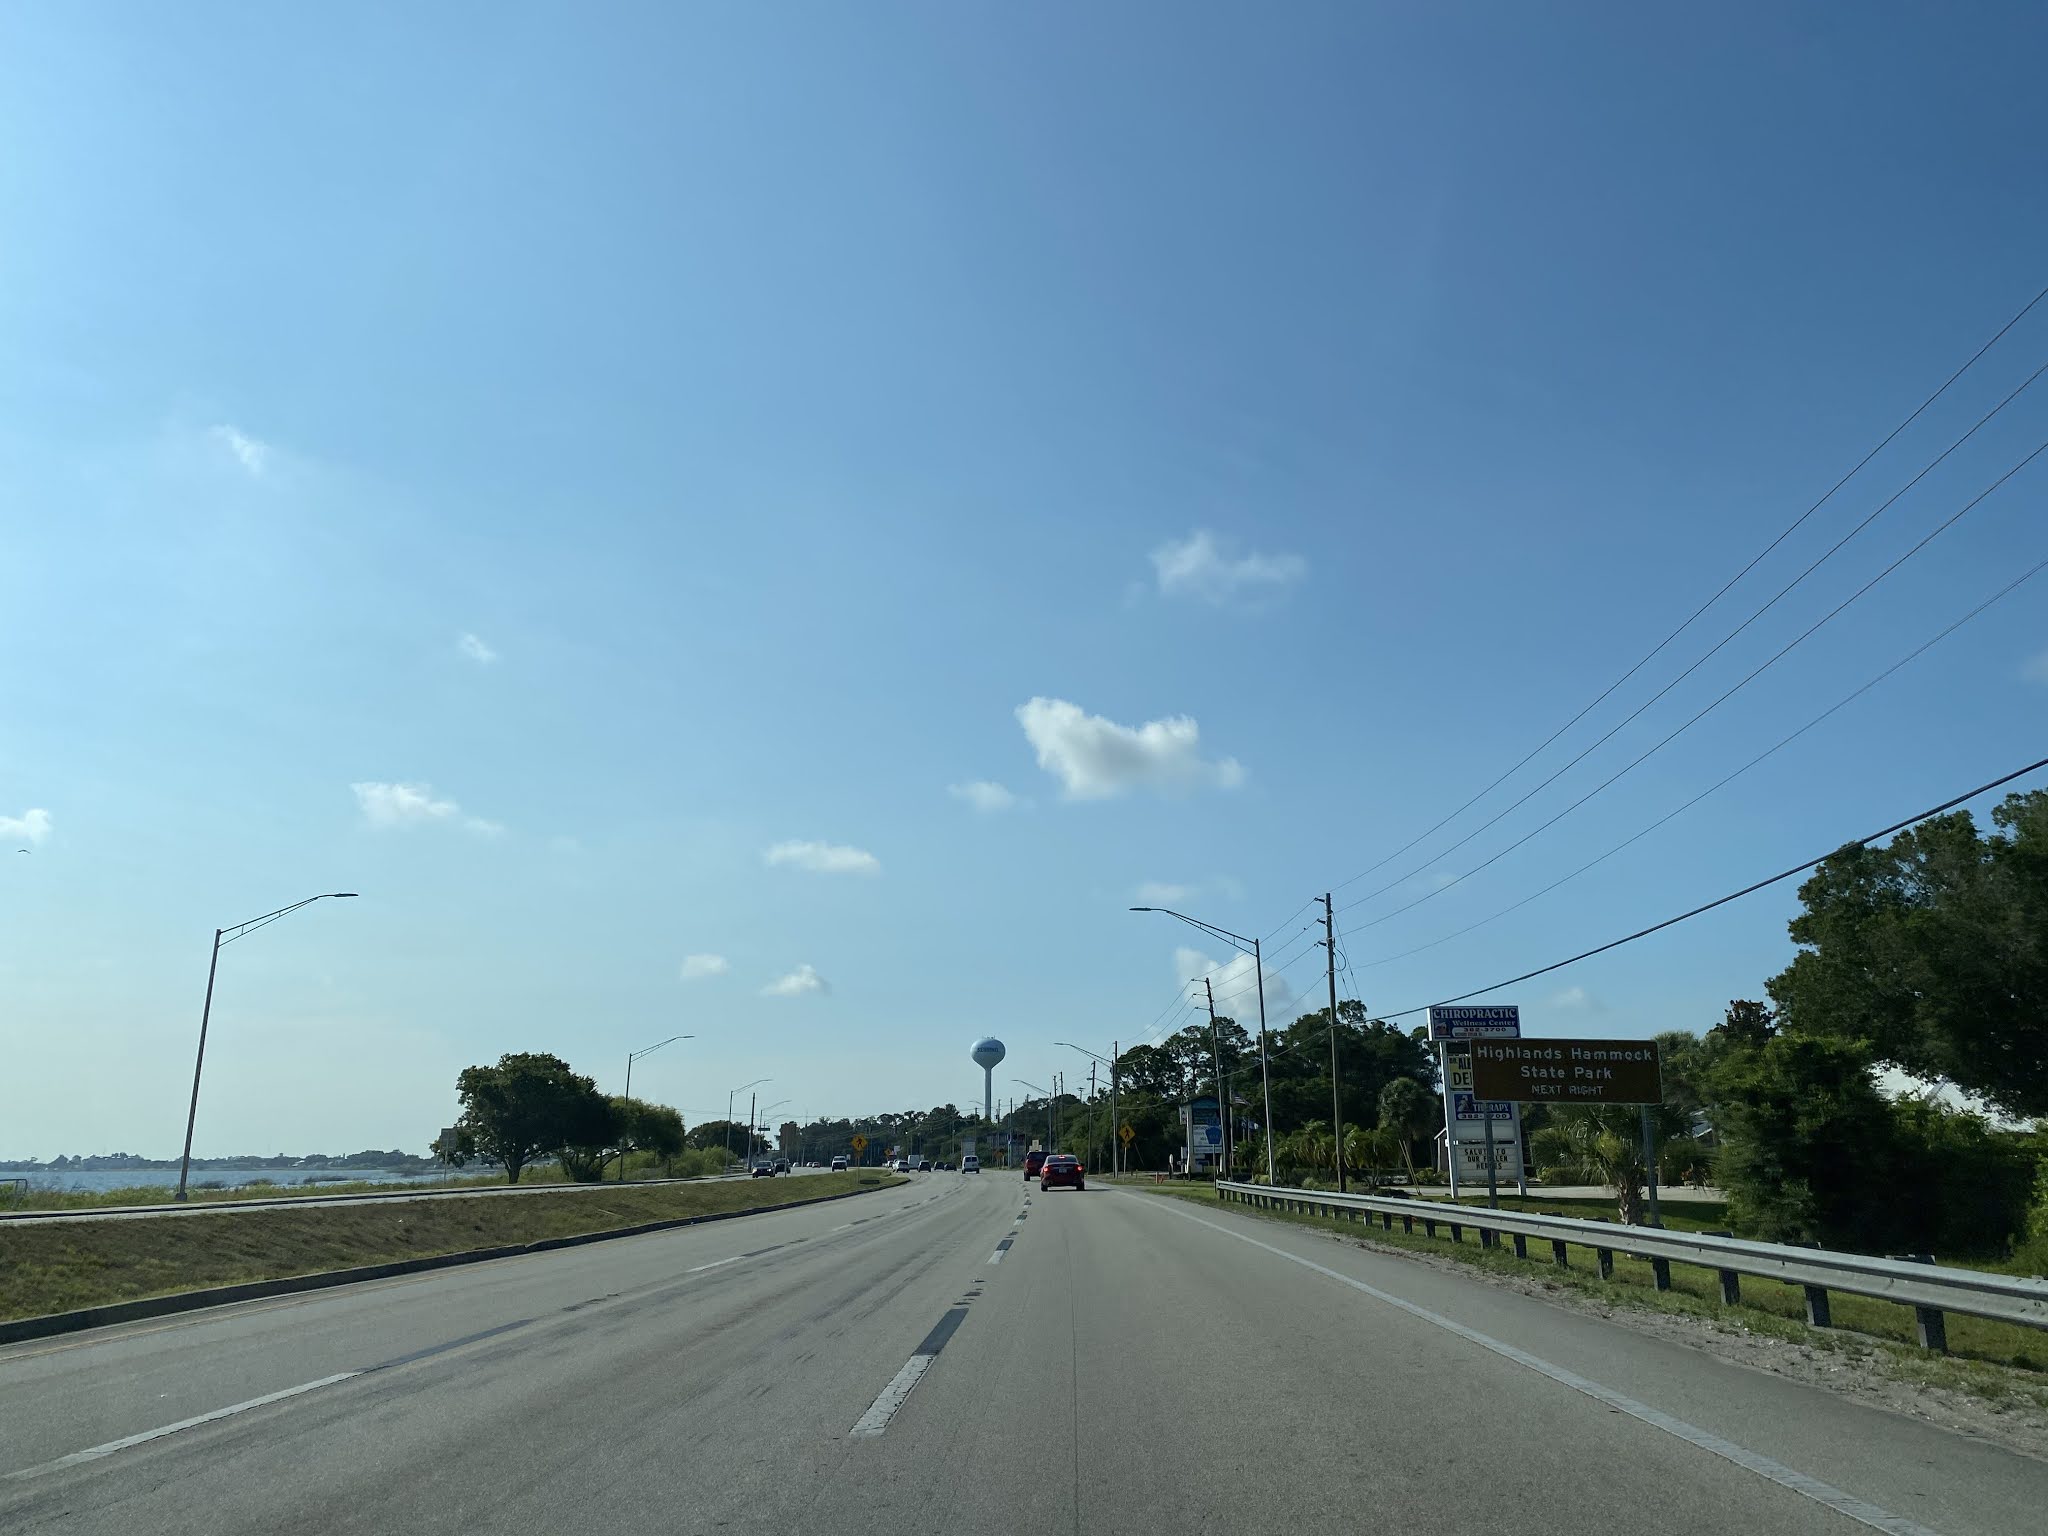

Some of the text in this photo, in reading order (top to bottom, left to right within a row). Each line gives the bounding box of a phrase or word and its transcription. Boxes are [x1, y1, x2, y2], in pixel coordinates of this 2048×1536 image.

[1434, 1009, 1516, 1018] CHIROPRACTIC
[1452, 1019, 1487, 1027] Wellness
[1477, 1045, 1652, 1062] Highlands Hammock
[1520, 1065, 1612, 1080] State Park
[1531, 1084, 1604, 1096] NEXT RIGHT
